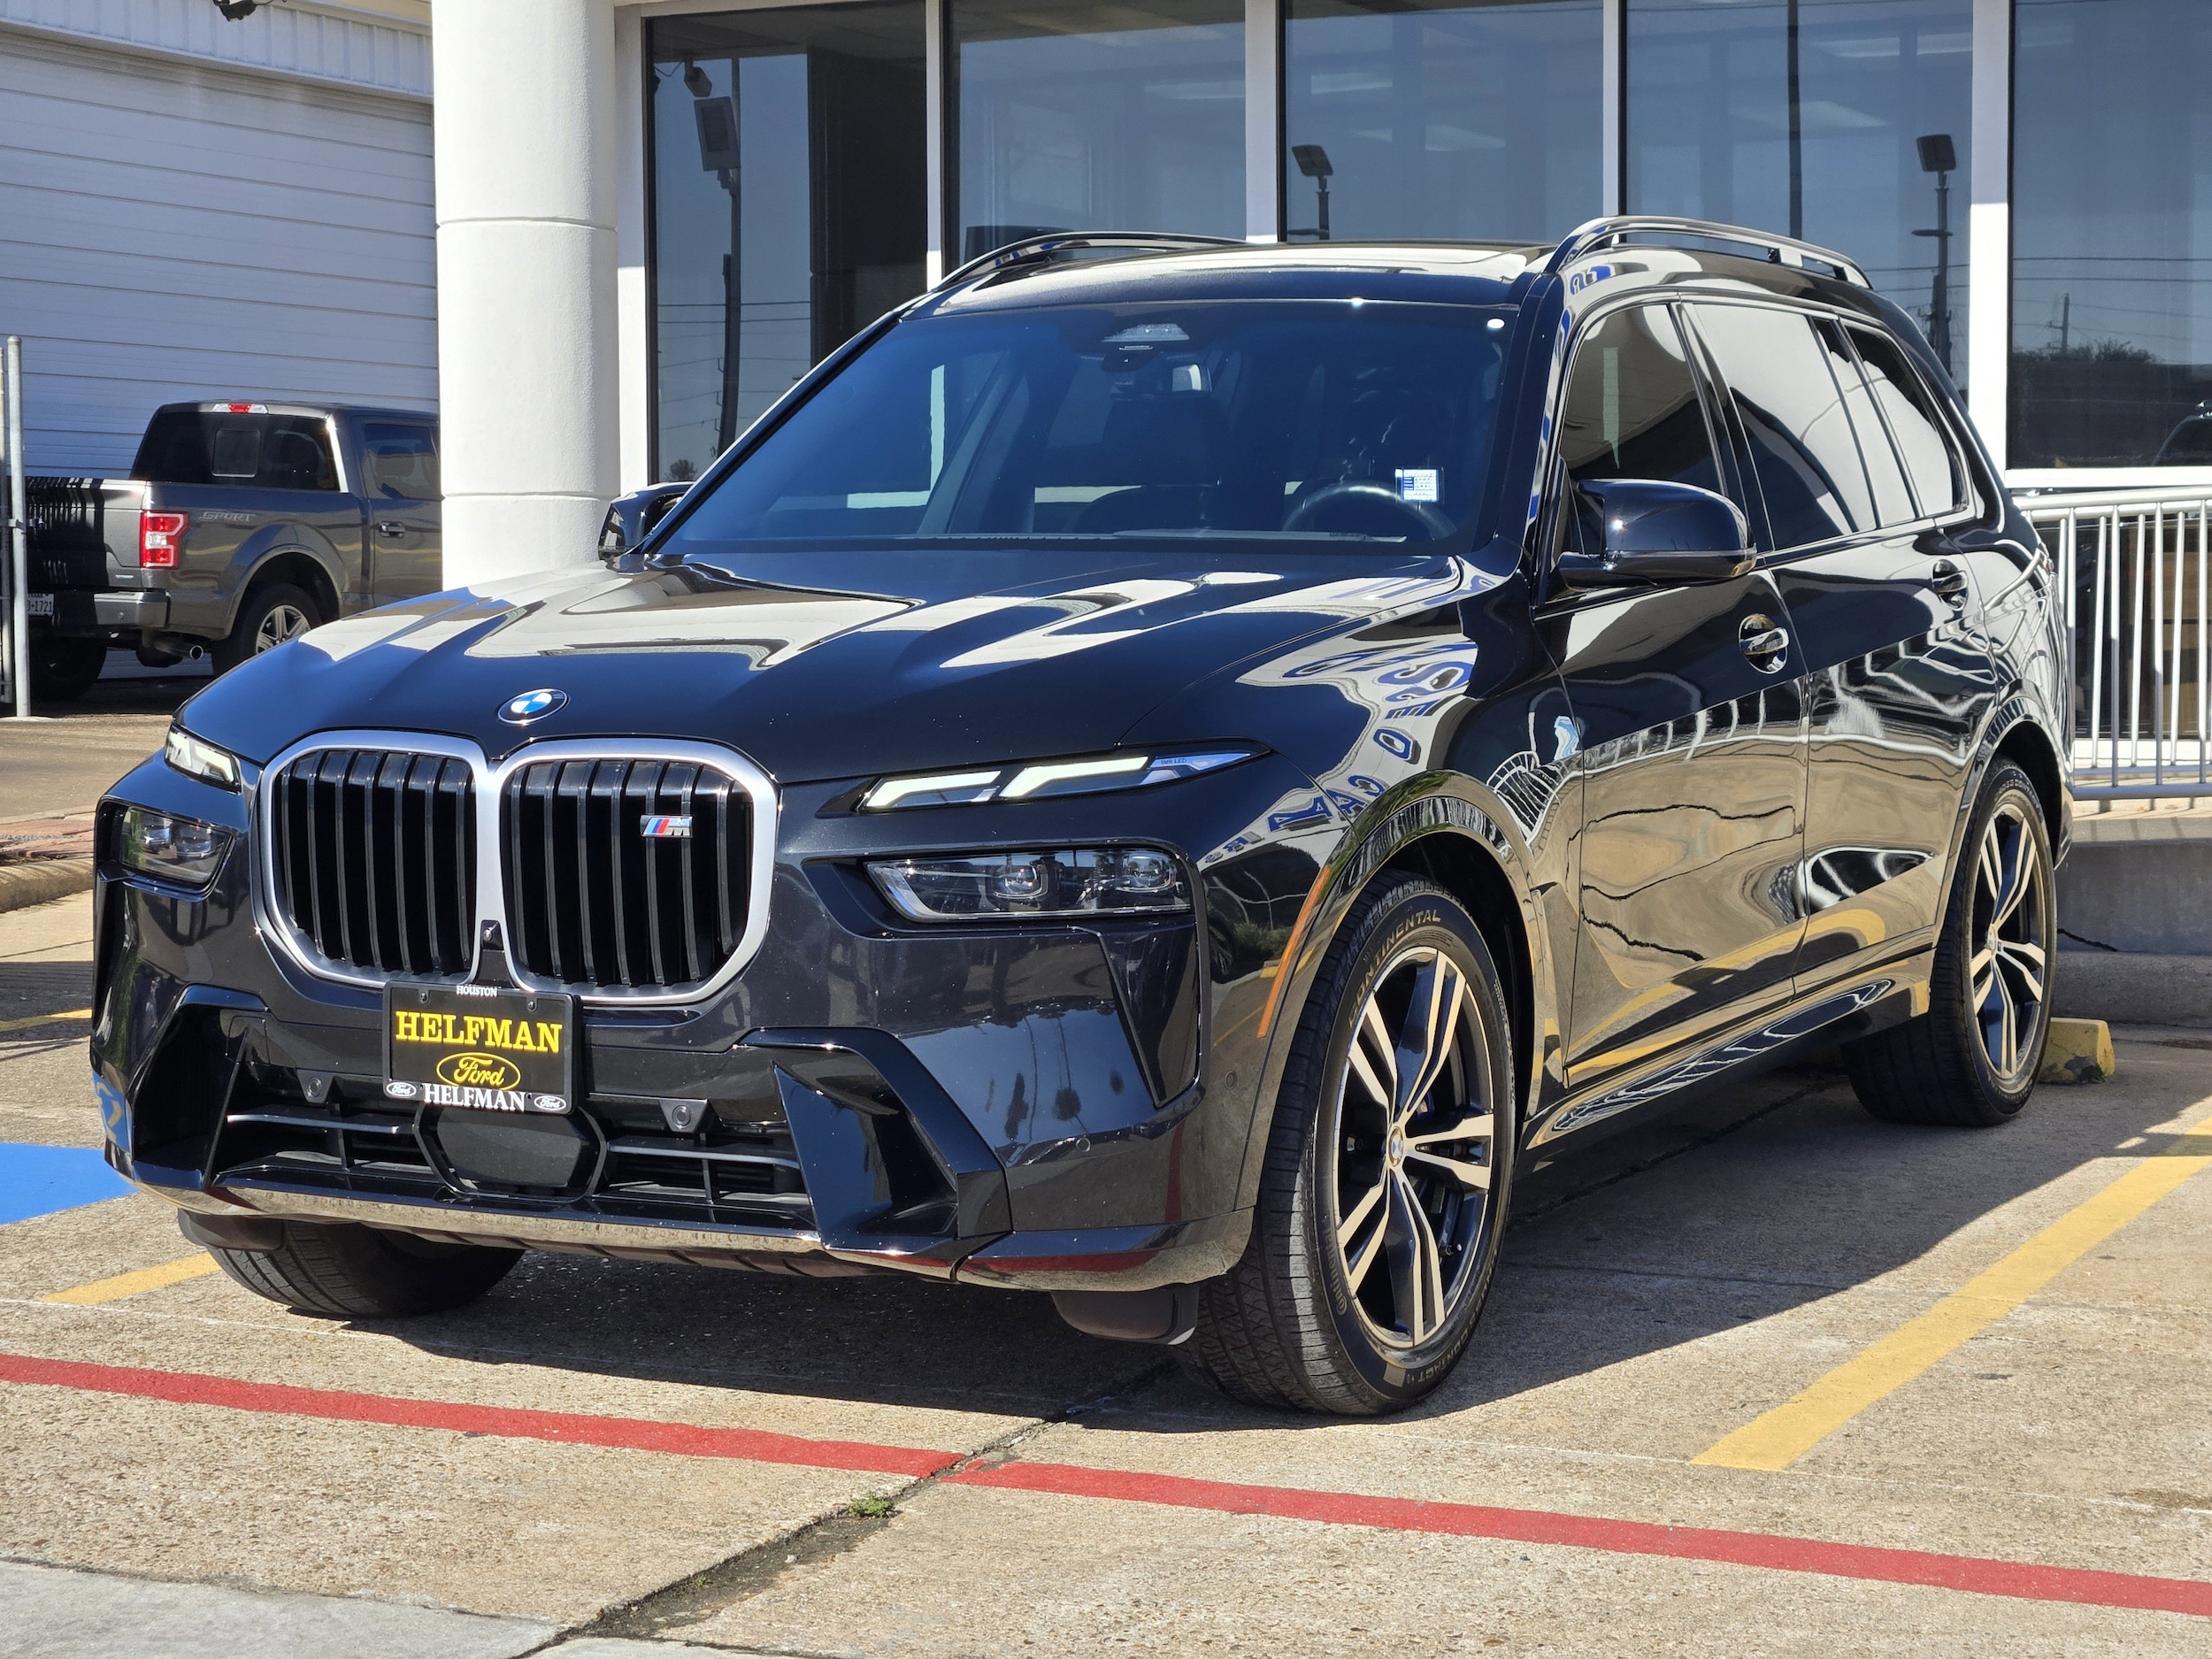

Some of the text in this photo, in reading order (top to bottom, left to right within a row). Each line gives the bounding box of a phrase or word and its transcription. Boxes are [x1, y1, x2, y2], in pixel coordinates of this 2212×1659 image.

[198, 511, 257, 521] SPORT
[1348, 909, 1441, 1028] CONTINENTAL
[457, 984, 497, 997] HOUSTON
[396, 1011, 563, 1053] HELFMAN
[453, 1056, 505, 1086] Ford
[391, 1083, 561, 1111] Ford HELFMAN Ford
[1324, 1228, 1348, 1315] Continental
